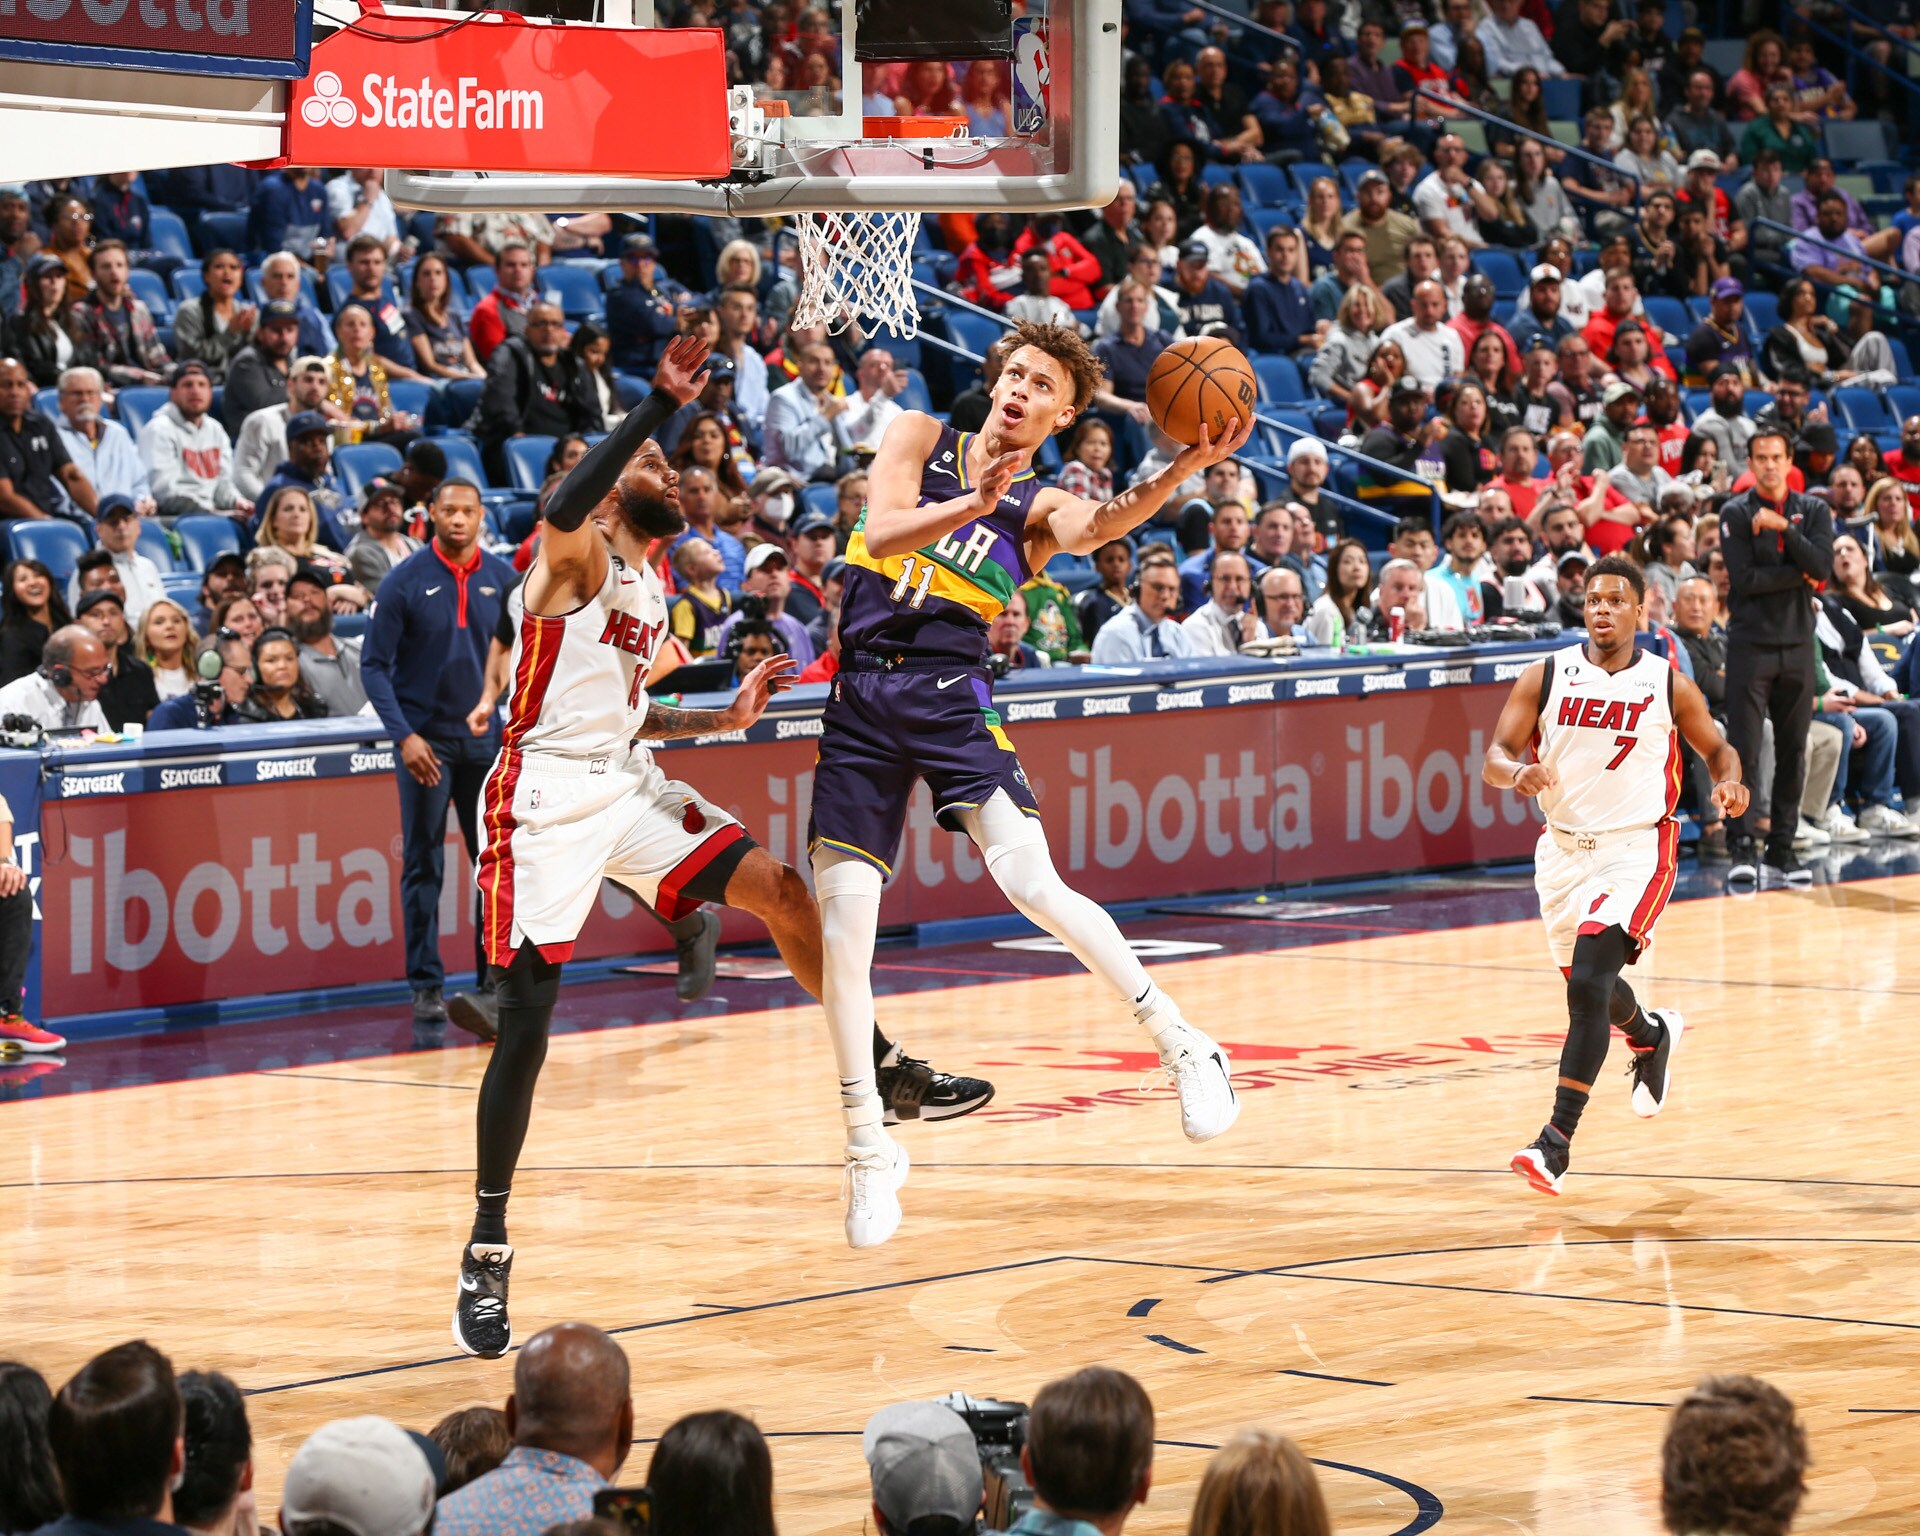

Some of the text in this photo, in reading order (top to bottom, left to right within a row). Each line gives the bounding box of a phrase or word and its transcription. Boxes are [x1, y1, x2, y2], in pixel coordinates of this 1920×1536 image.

[941, 450, 955, 463] 6
[889, 557, 935, 609] 11
[599, 608, 664, 662] HEAT
[1362, 671, 1406, 692] SEATGEEK
[1429, 666, 1472, 687] SEATGEEK
[1494, 662, 1531, 682] SEATG
[1228, 682, 1275, 704] SEATGEEK
[1295, 677, 1340, 698] SEATGEEK
[1634, 680, 1656, 690] UKG
[1007, 700, 1057, 722] SEATGEEK
[1082, 695, 1131, 716] SEATGEEK
[1156, 689, 1204, 711] SEATGEEK
[1557, 693, 1655, 732] HEAT
[350, 752, 396, 774] SEATGE
[1605, 735, 1638, 771] 7
[160, 764, 222, 789] SEATGEEK
[256, 756, 317, 781] SEATGEEK
[62, 772, 125, 798] SEATGEEK
[1069, 743, 1313, 871] ibotta
[70, 828, 393, 975] ibotta
